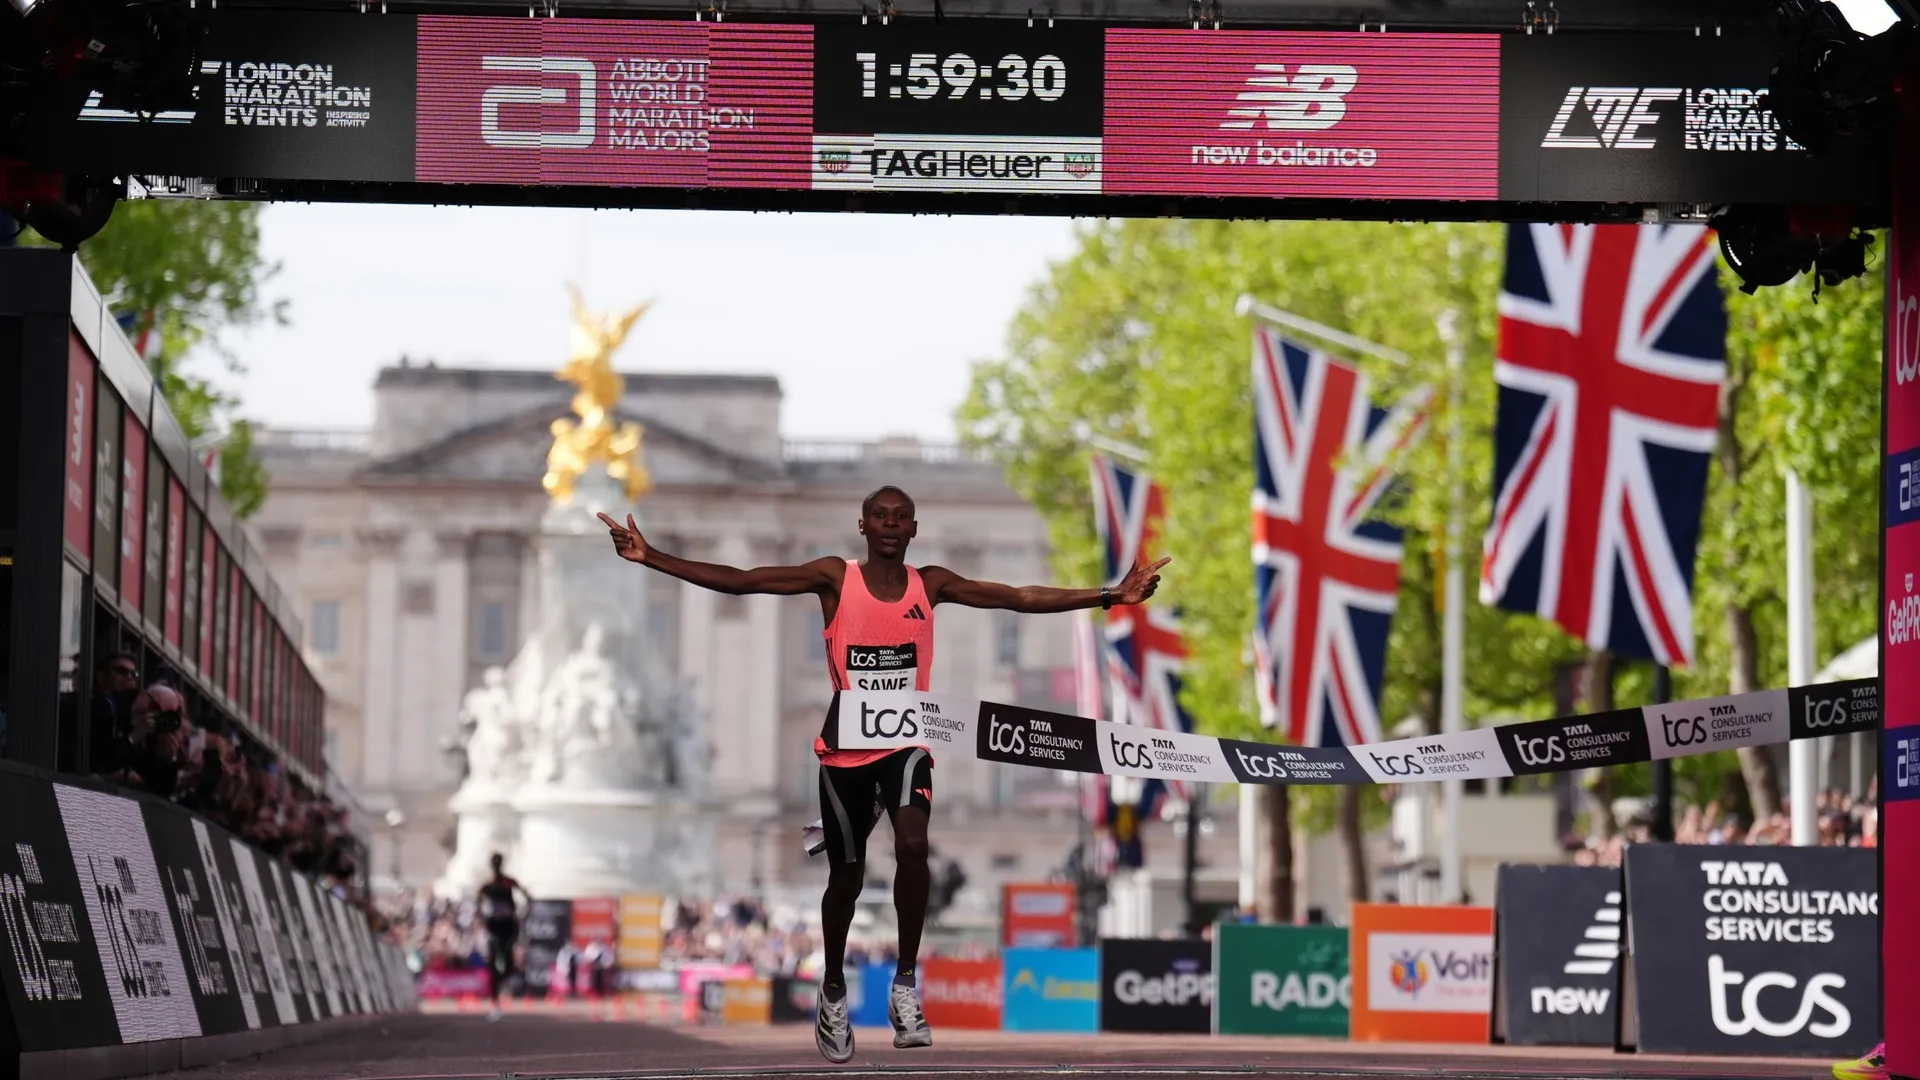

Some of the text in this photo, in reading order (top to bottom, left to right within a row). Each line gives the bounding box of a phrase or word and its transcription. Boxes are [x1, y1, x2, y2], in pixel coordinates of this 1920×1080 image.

[225, 61, 333, 85] LONDON
[609, 57, 711, 82] ABBOTT
[856, 52, 1067, 101] 1:59:30
[225, 83, 371, 107] MARATHON
[609, 81, 705, 104] WORLD
[225, 105, 318, 127] EVENTS
[326, 111, 370, 120] INSPIRING
[326, 119, 367, 127] ACTIVITY
[609, 105, 754, 129] MARATHON
[608, 128, 711, 151] MAJORS
[1684, 130, 1778, 152] EVENTS
[1192, 140, 1378, 167] new balance
[1895, 278, 1920, 386] tc
[851, 649, 877, 667] tcs
[878, 653, 913, 661] CONSULTANCY
[1851, 686, 1878, 698] TATA
[919, 702, 941, 714] TATA
[1709, 705, 1737, 717] TATA
[1804, 695, 1847, 729] tcs
[861, 701, 918, 738] tcs
[922, 715, 966, 732] CONSULTANCY
[1029, 719, 1052, 733] TATA
[1711, 712, 1773, 730] CONSULTANCY
[923, 728, 952, 743] SERVICES
[988, 713, 1025, 755] tcs
[1562, 723, 1593, 736] TATA
[1661, 713, 1707, 748] tcs
[1711, 727, 1752, 742] SERVICES
[1028, 733, 1083, 751] CONSULTANCY
[1151, 738, 1176, 750] TATA
[1566, 731, 1631, 749] CONSULTANCY
[1029, 746, 1065, 761] SERVICES
[1110, 732, 1154, 770] tcs
[1153, 751, 1211, 765] CONSULTANCY
[1278, 751, 1306, 762] TATA
[1416, 744, 1446, 755] TATA
[1422, 751, 1486, 765] CONSULTANCY
[1513, 733, 1566, 766] tcs
[1569, 746, 1612, 761] SERVICES
[1157, 762, 1197, 774] SERVICES
[1235, 748, 1287, 779] tcs
[1284, 761, 1345, 771] CONSULTANCY
[1369, 752, 1424, 776] tcs
[1428, 763, 1470, 775] SERVICES
[1290, 770, 1332, 779] SERVICES
[1700, 861, 1789, 886] TATA
[88, 853, 147, 999] tcs
[1704, 917, 1835, 943] SERVICES
[1530, 986, 1611, 1015] new
[1707, 953, 1852, 1039] tcs
